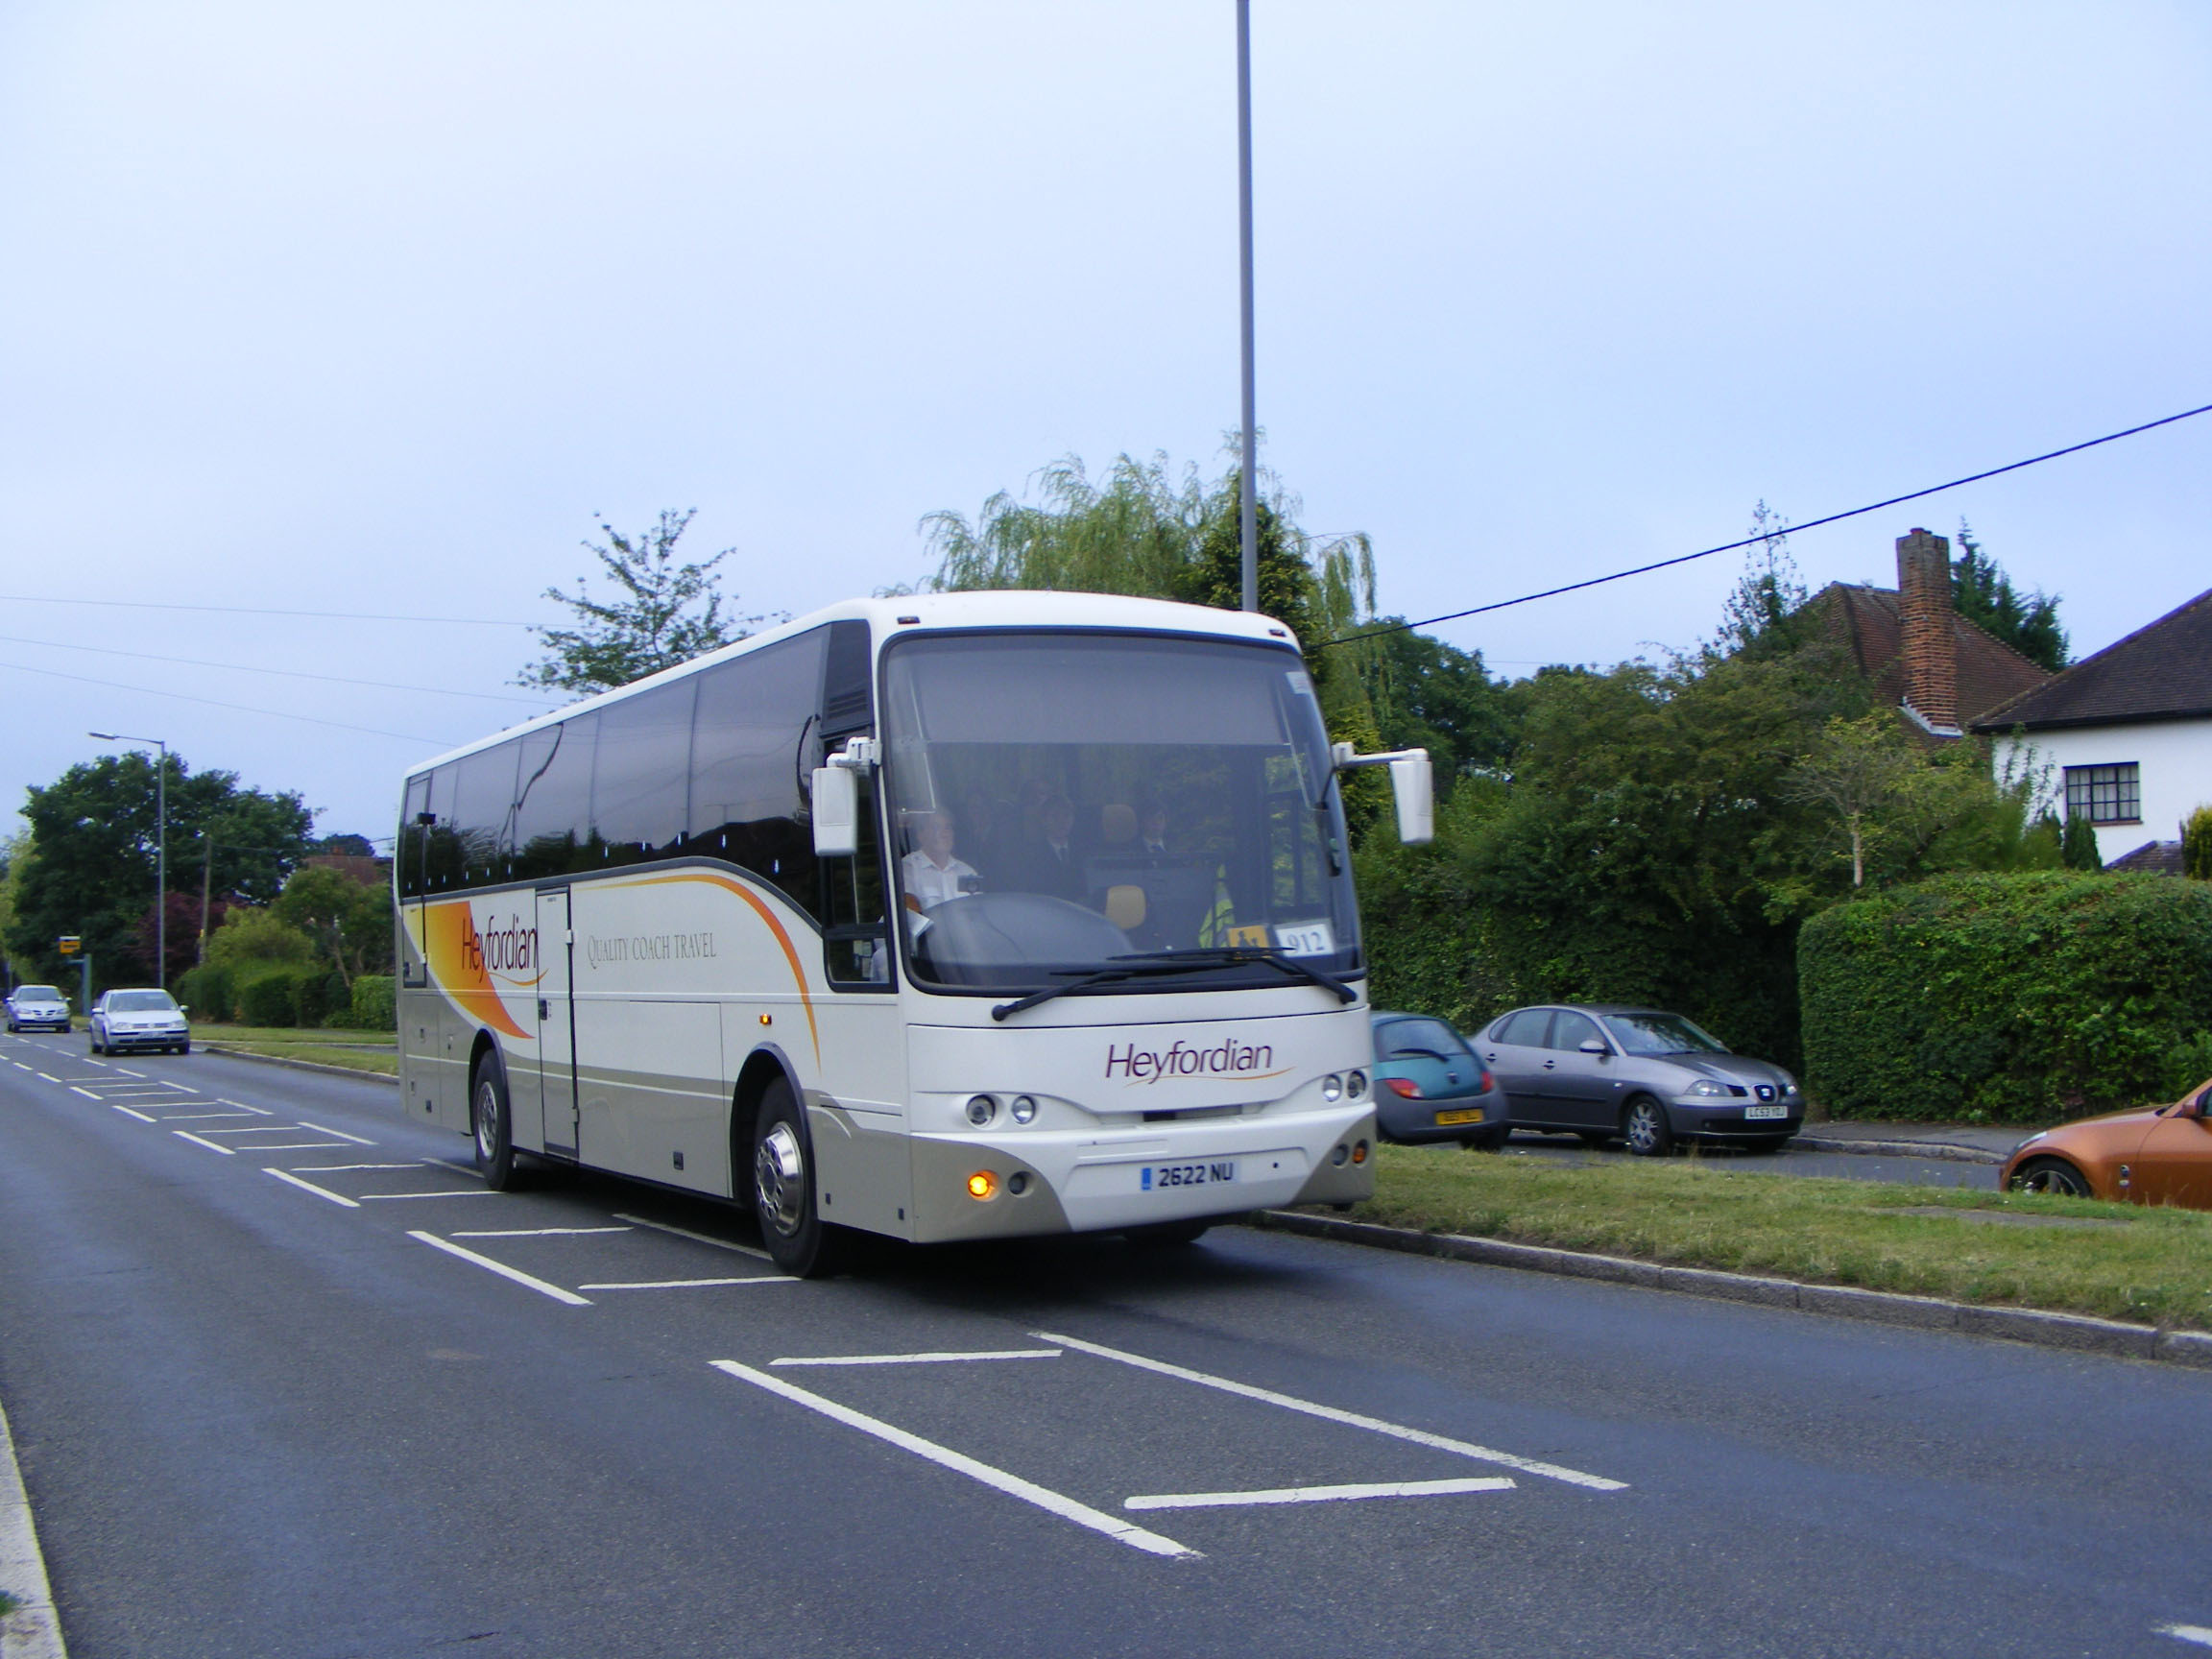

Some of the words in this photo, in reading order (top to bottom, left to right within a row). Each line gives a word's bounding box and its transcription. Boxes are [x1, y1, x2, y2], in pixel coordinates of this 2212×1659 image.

[462, 914, 538, 984] Heyfordian
[588, 935, 628, 970] QUALITY
[632, 935, 670, 960] COACH
[674, 932, 717, 958] TRAVEL
[1287, 931, 1325, 953] 912
[1105, 1038, 1272, 1084] Heyfordian
[1158, 1165, 1206, 1188] 2622
[1210, 1163, 1234, 1183] NU
